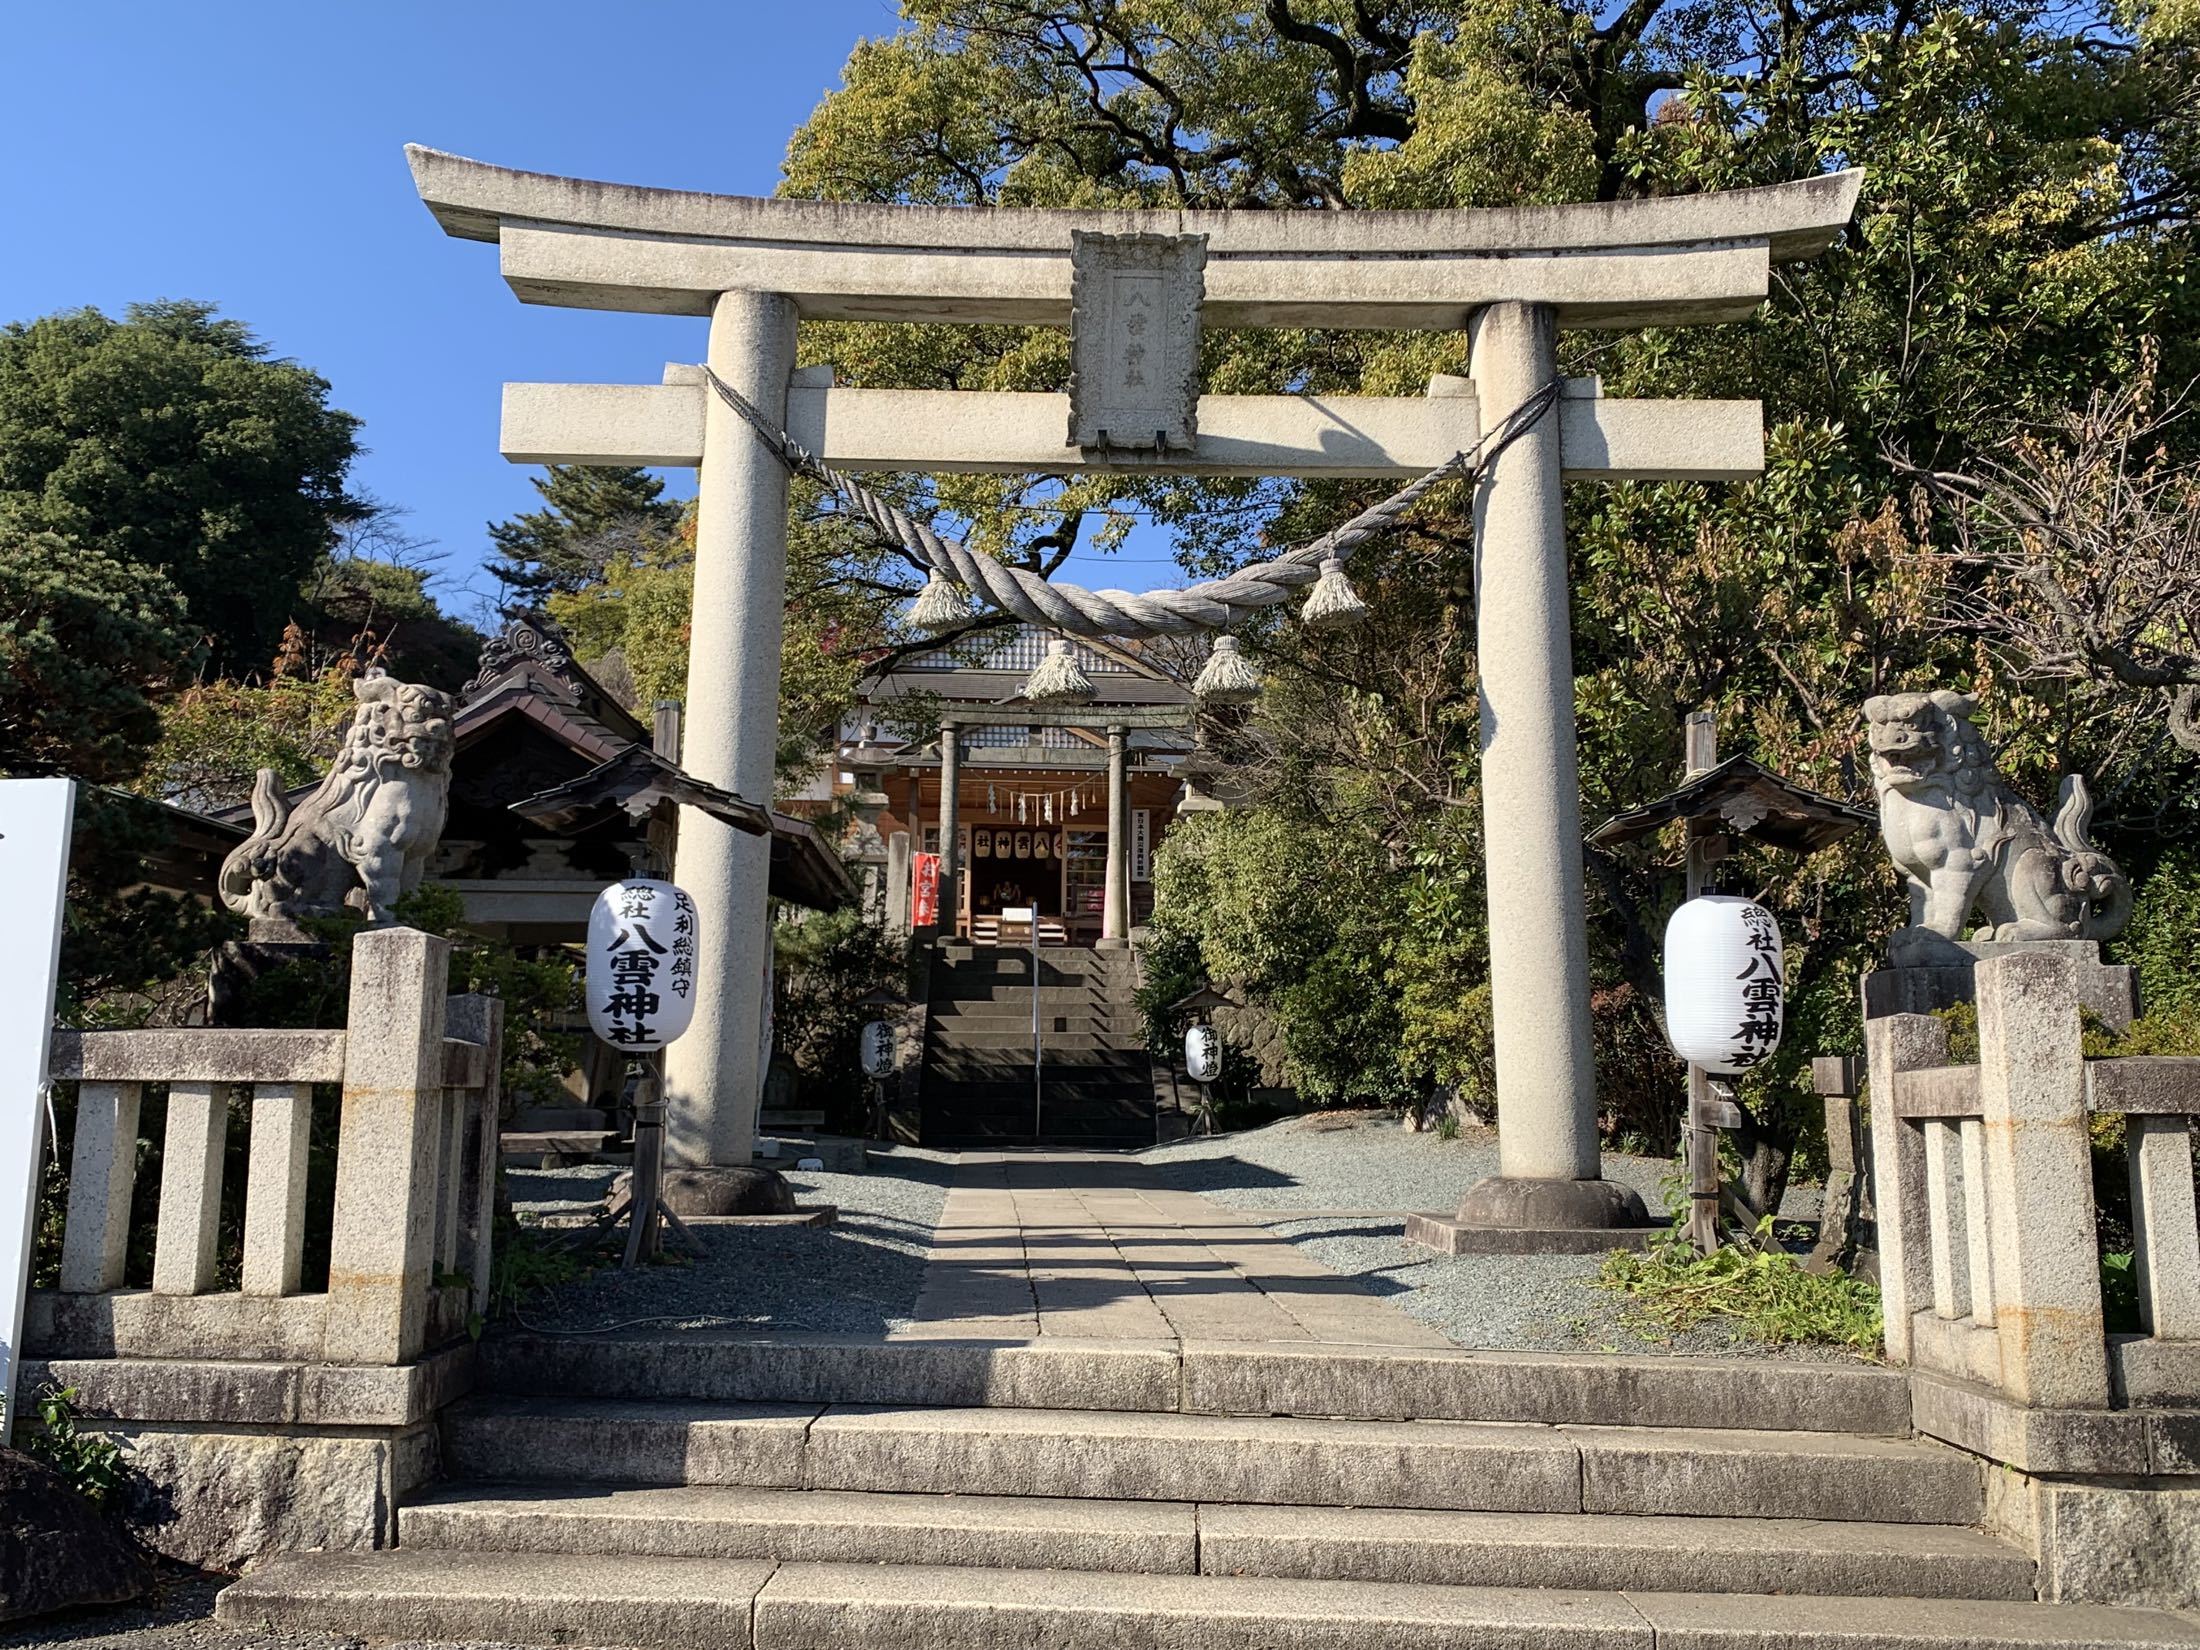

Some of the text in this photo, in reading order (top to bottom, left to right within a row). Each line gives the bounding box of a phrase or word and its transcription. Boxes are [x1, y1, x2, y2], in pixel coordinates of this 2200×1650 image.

[671, 892, 694, 999] 足利総鎮守
